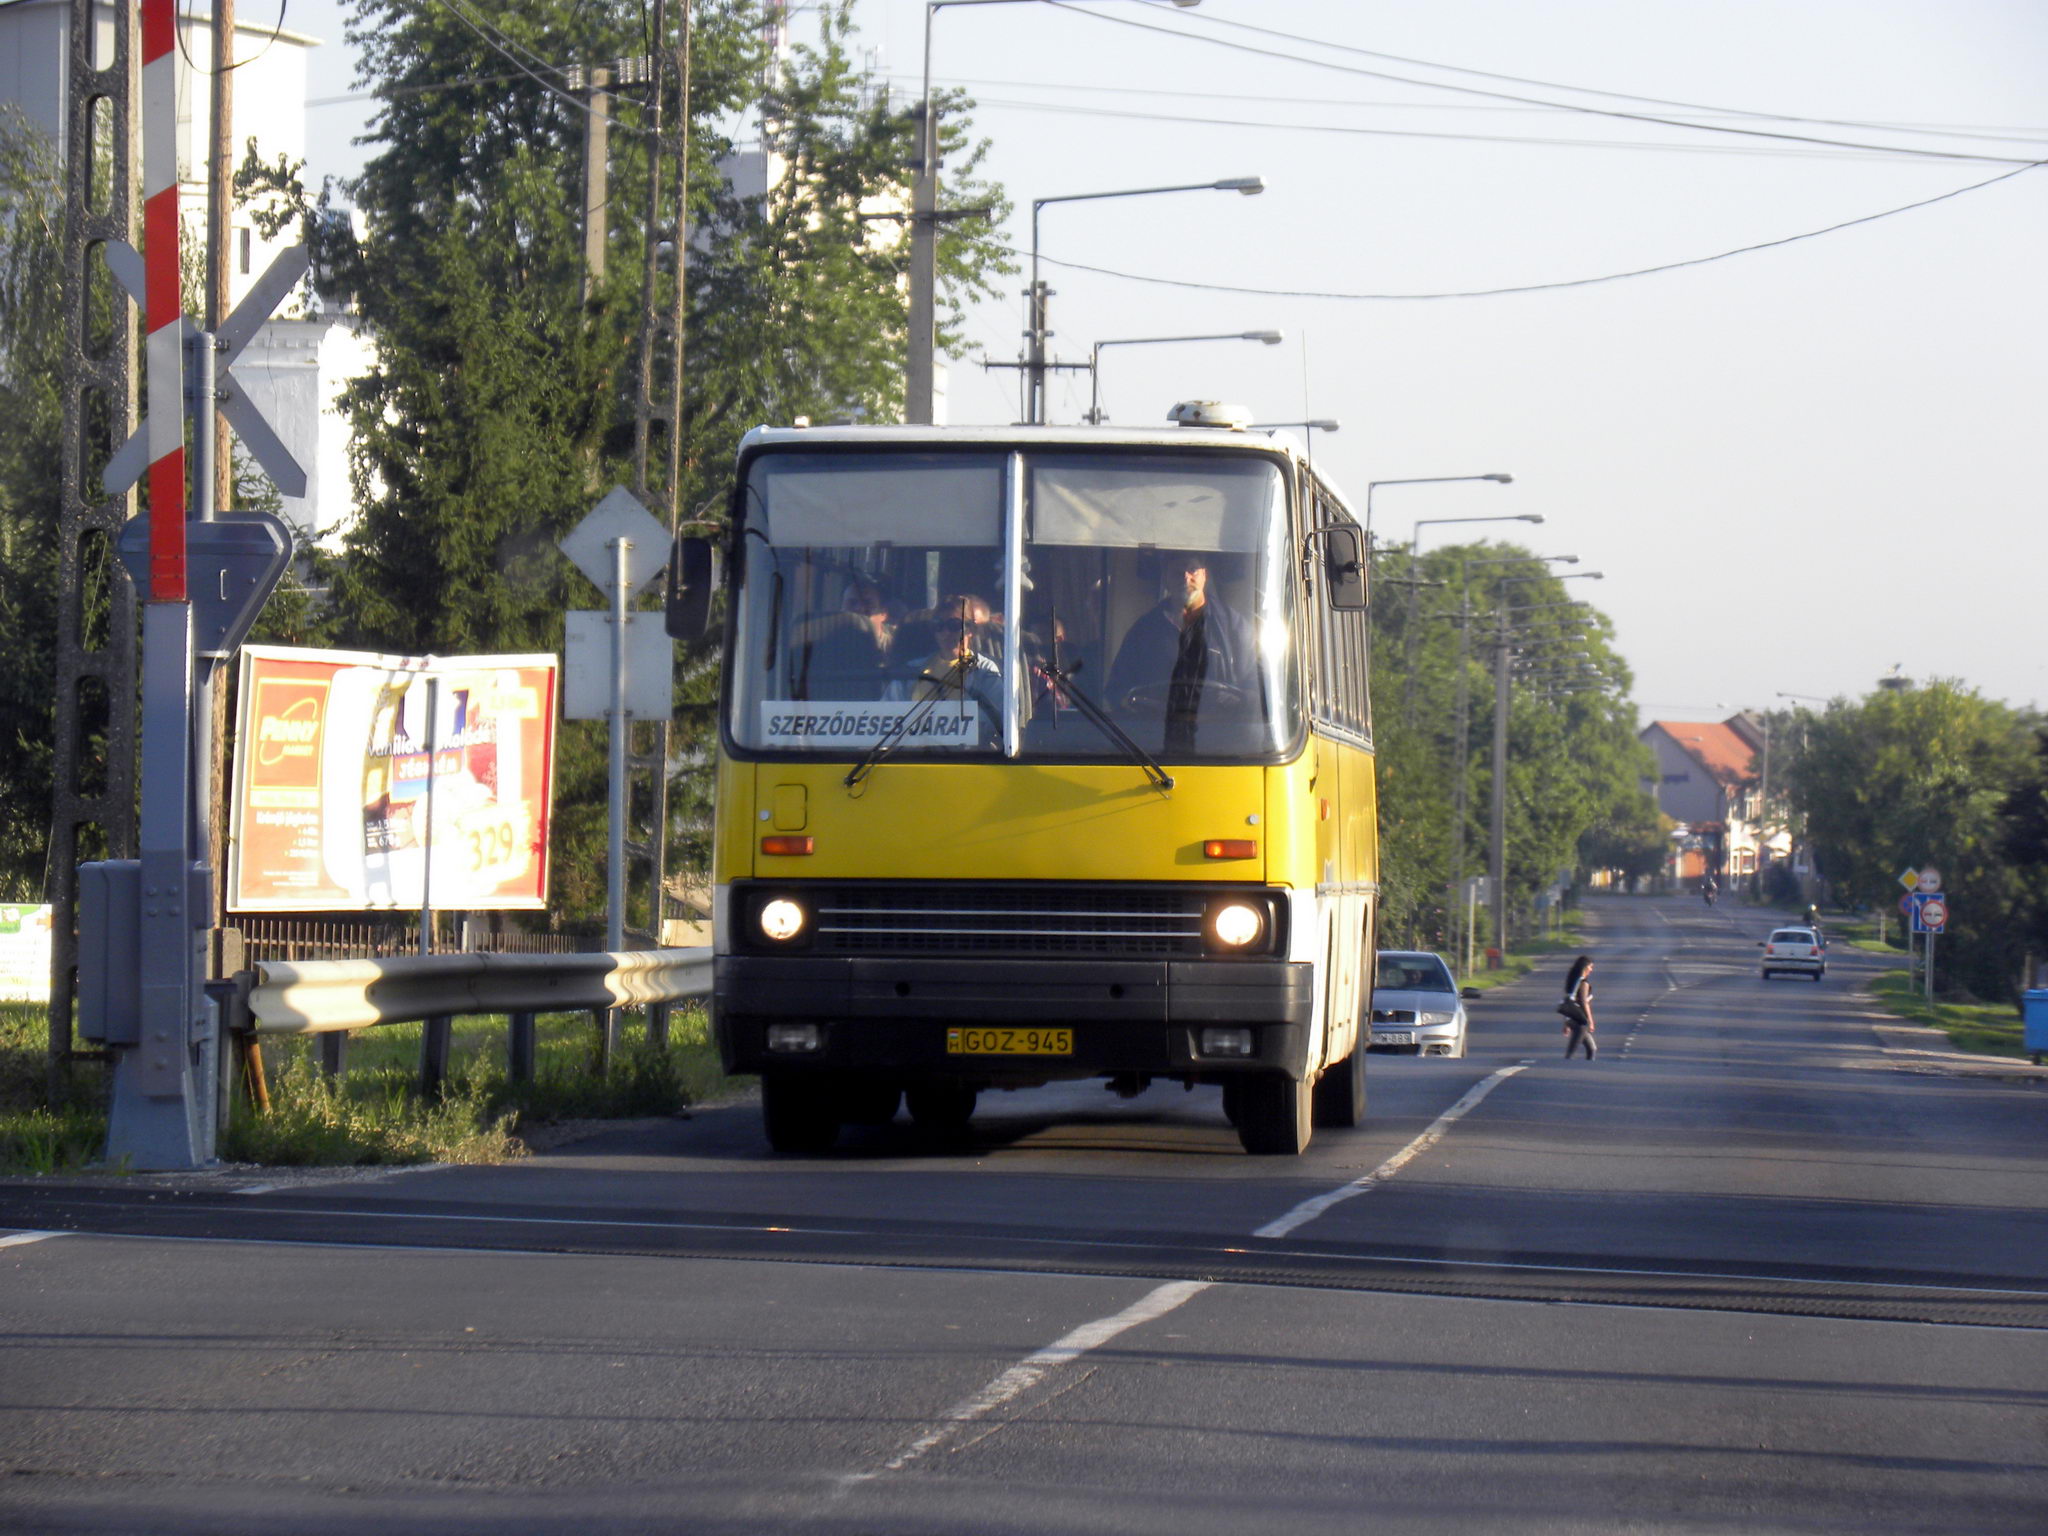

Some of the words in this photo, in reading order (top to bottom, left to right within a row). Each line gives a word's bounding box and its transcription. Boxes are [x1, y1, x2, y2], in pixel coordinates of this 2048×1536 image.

[258, 715, 320, 742] PENNY
[768, 710, 904, 736] SZERZŐDÉSES
[908, 710, 974, 736] JÁRAT
[471, 822, 514, 871] 329
[966, 1031, 1068, 1051] GOZ-945
